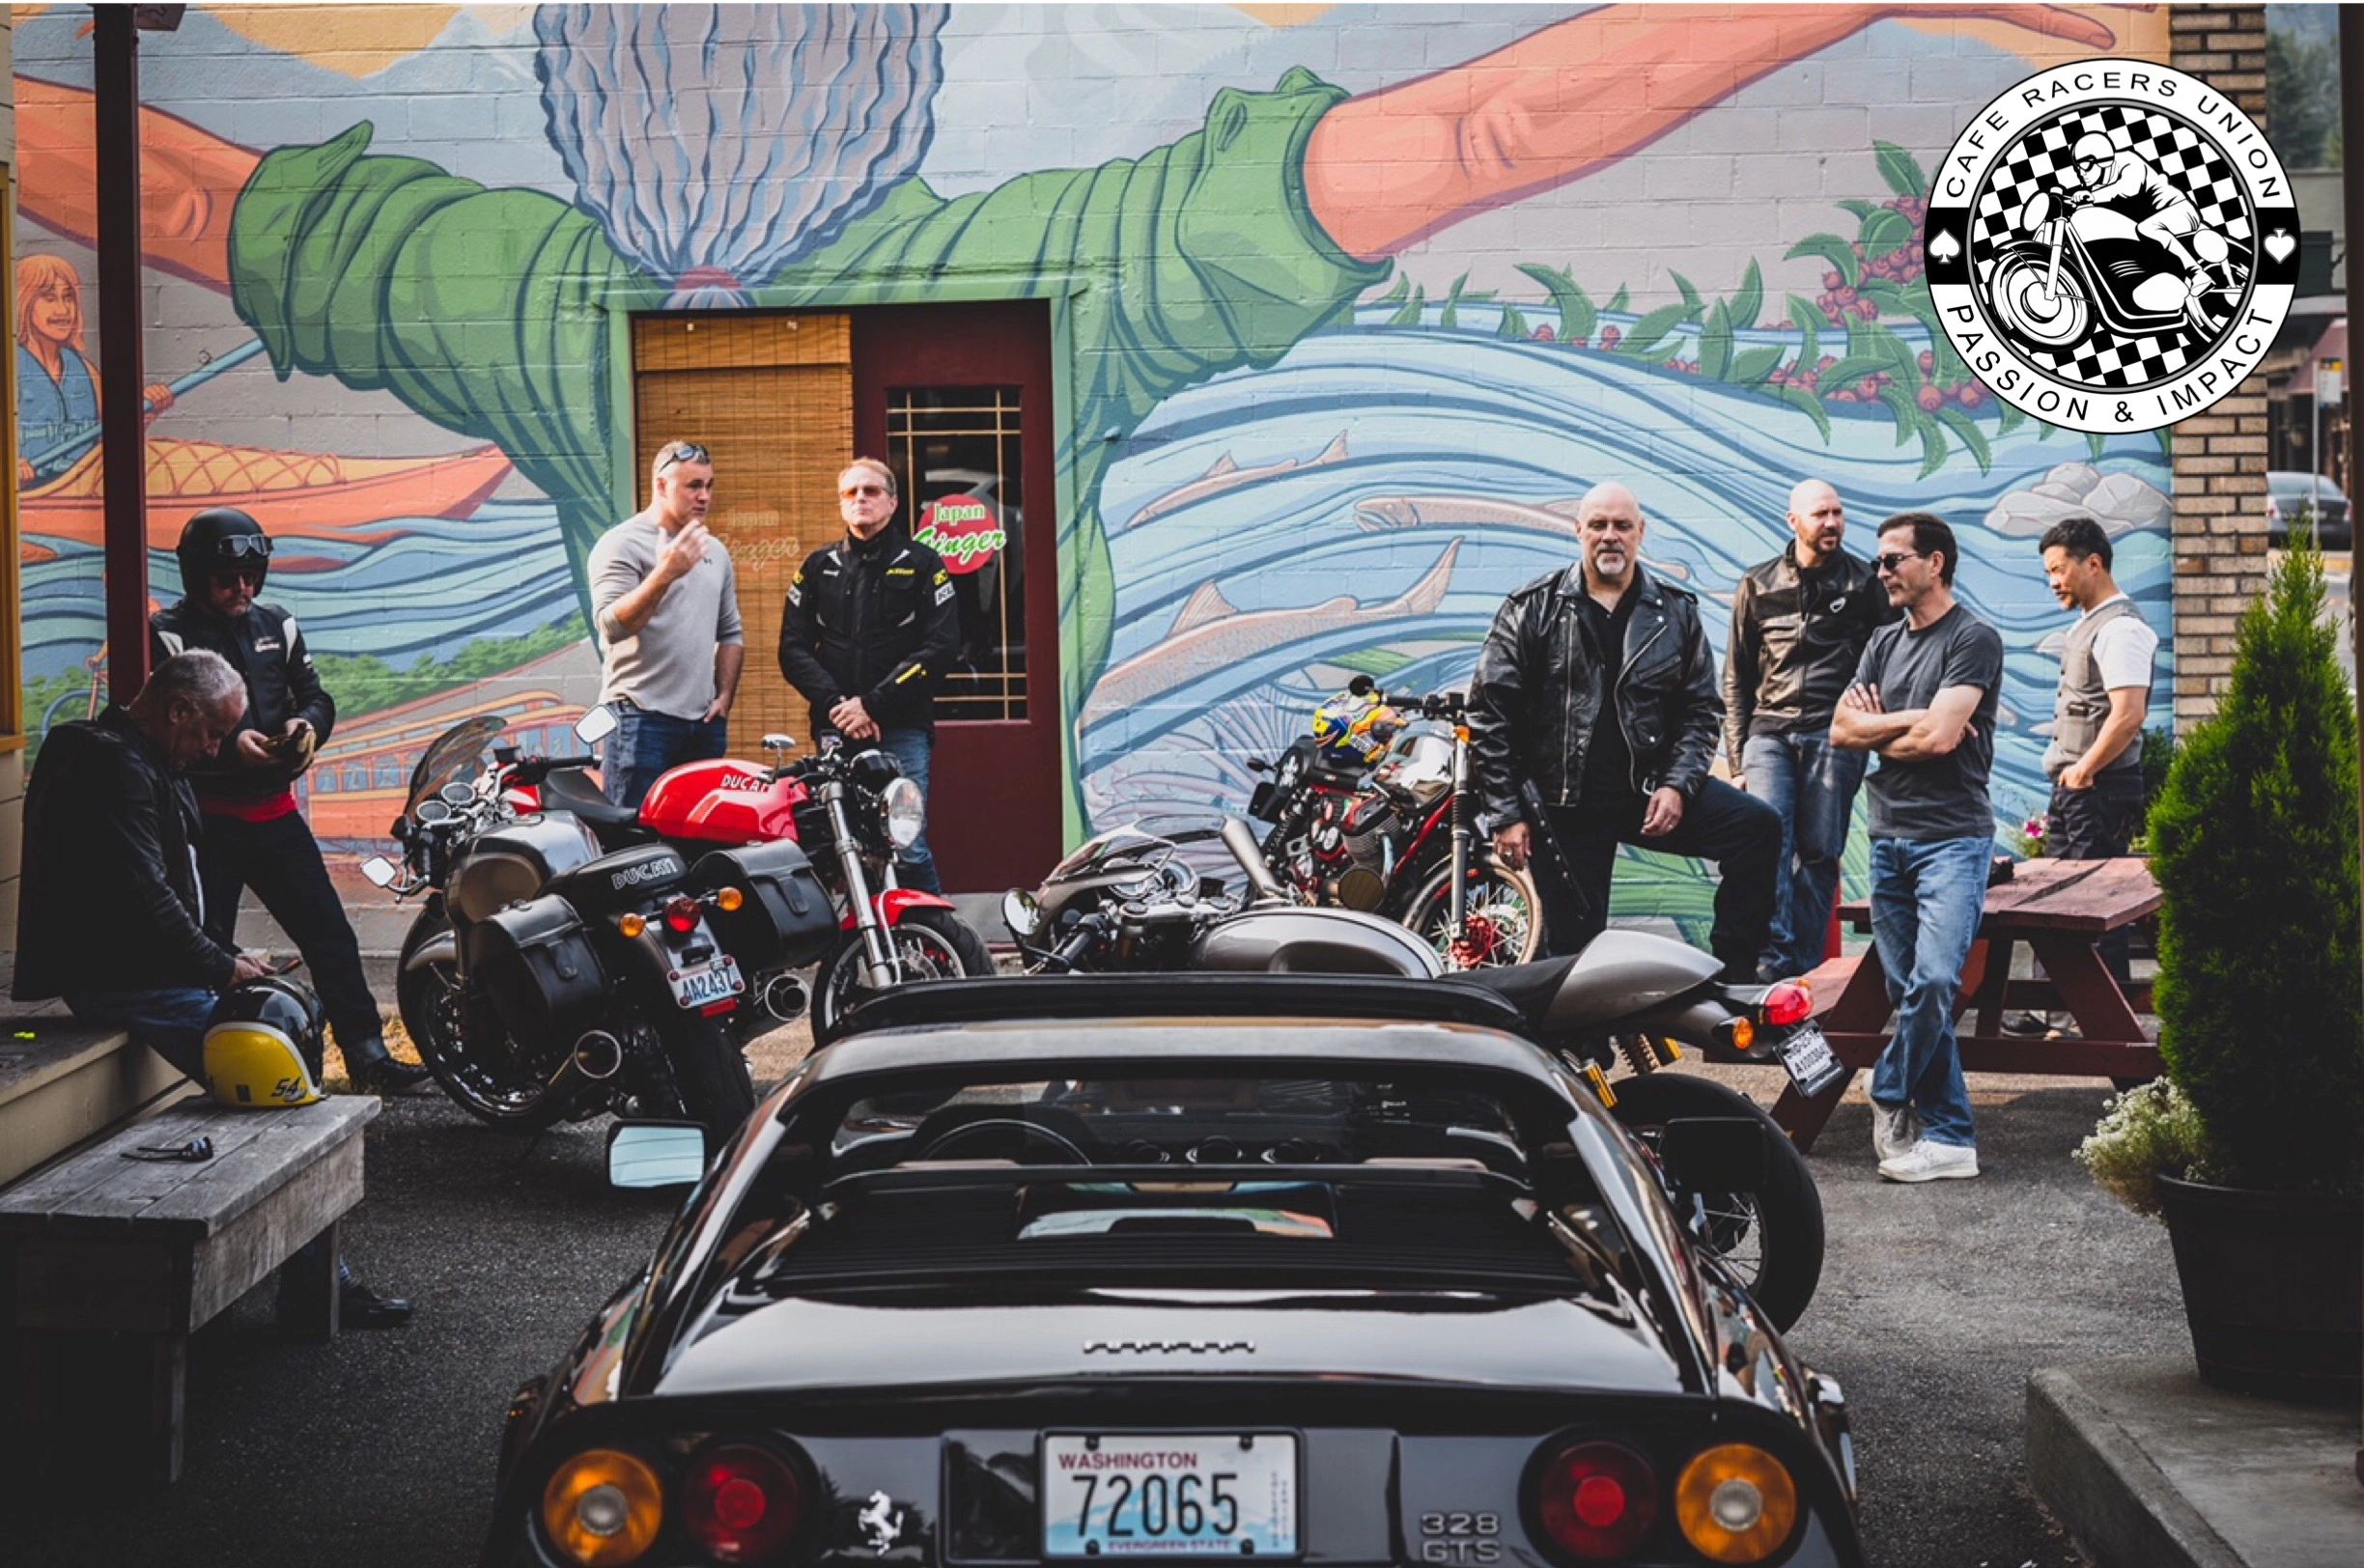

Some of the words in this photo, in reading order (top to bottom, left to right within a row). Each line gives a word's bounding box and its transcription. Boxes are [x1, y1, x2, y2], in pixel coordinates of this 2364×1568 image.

[933, 502, 985, 526] Japan
[611, 857, 678, 889] DUCATI
[1058, 1452, 1197, 1470] WASHINGTON
[1072, 1472, 1238, 1537] 72065
[1421, 1512, 1499, 1535] 328
[1191, 1538, 1231, 1551] STATE
[1422, 1539, 1501, 1562] GTS
